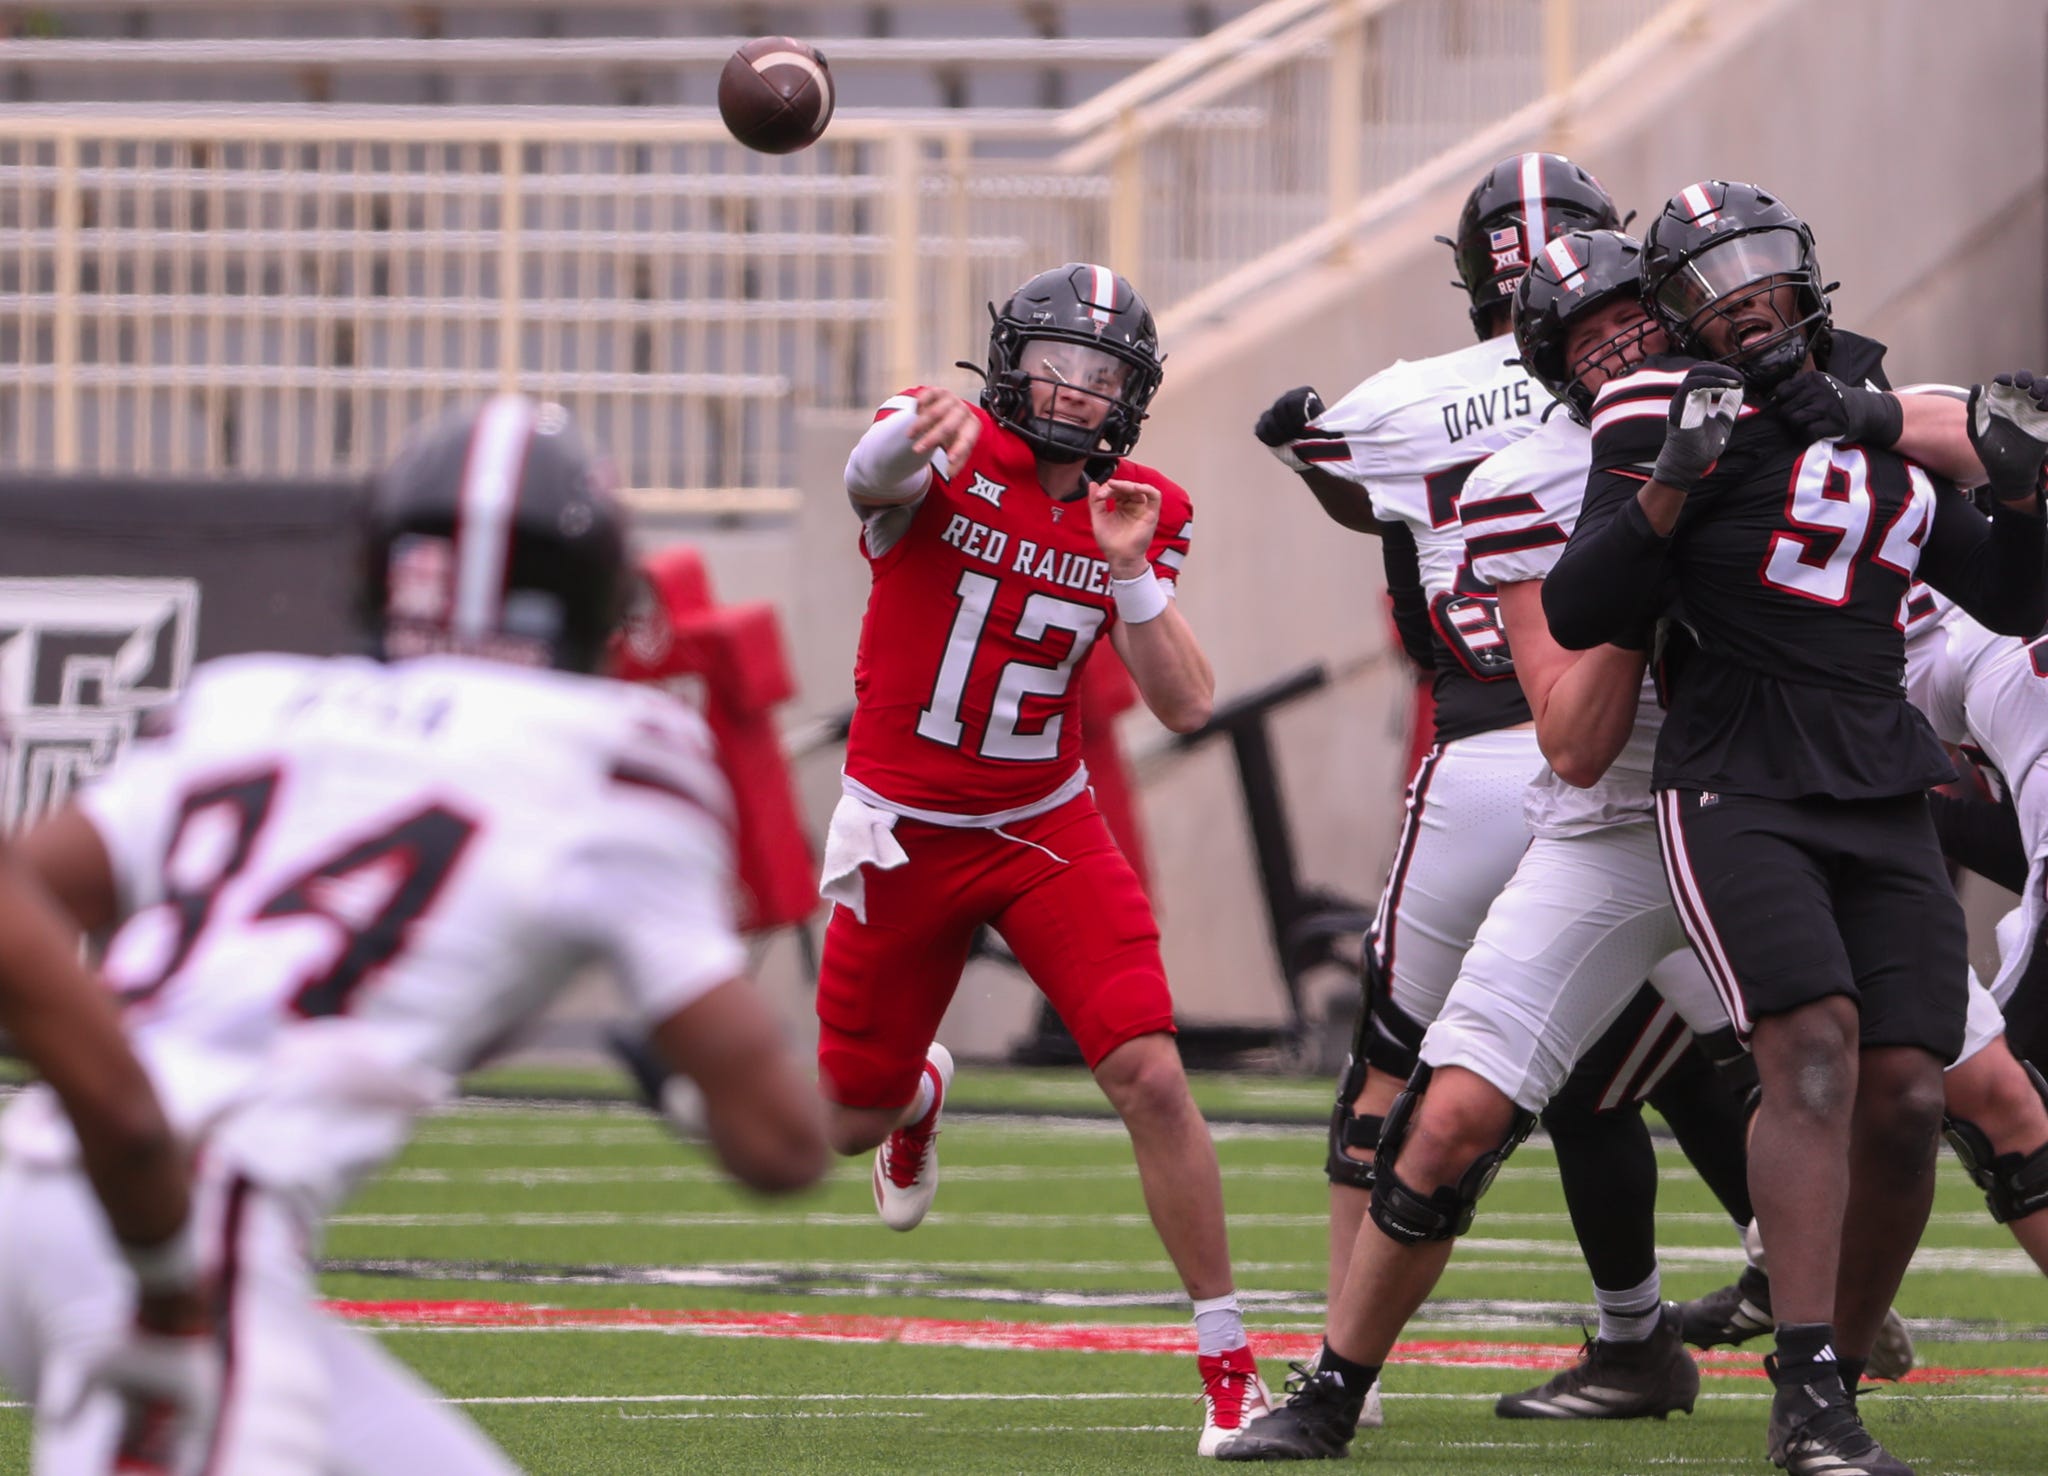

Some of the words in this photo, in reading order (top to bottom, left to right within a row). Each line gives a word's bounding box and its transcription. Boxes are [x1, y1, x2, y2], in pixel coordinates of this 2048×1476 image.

[1442, 379, 1531, 444] DAVIS
[941, 513, 1008, 564] RED
[1758, 441, 1937, 633] 94
[915, 568, 1107, 762] 12
